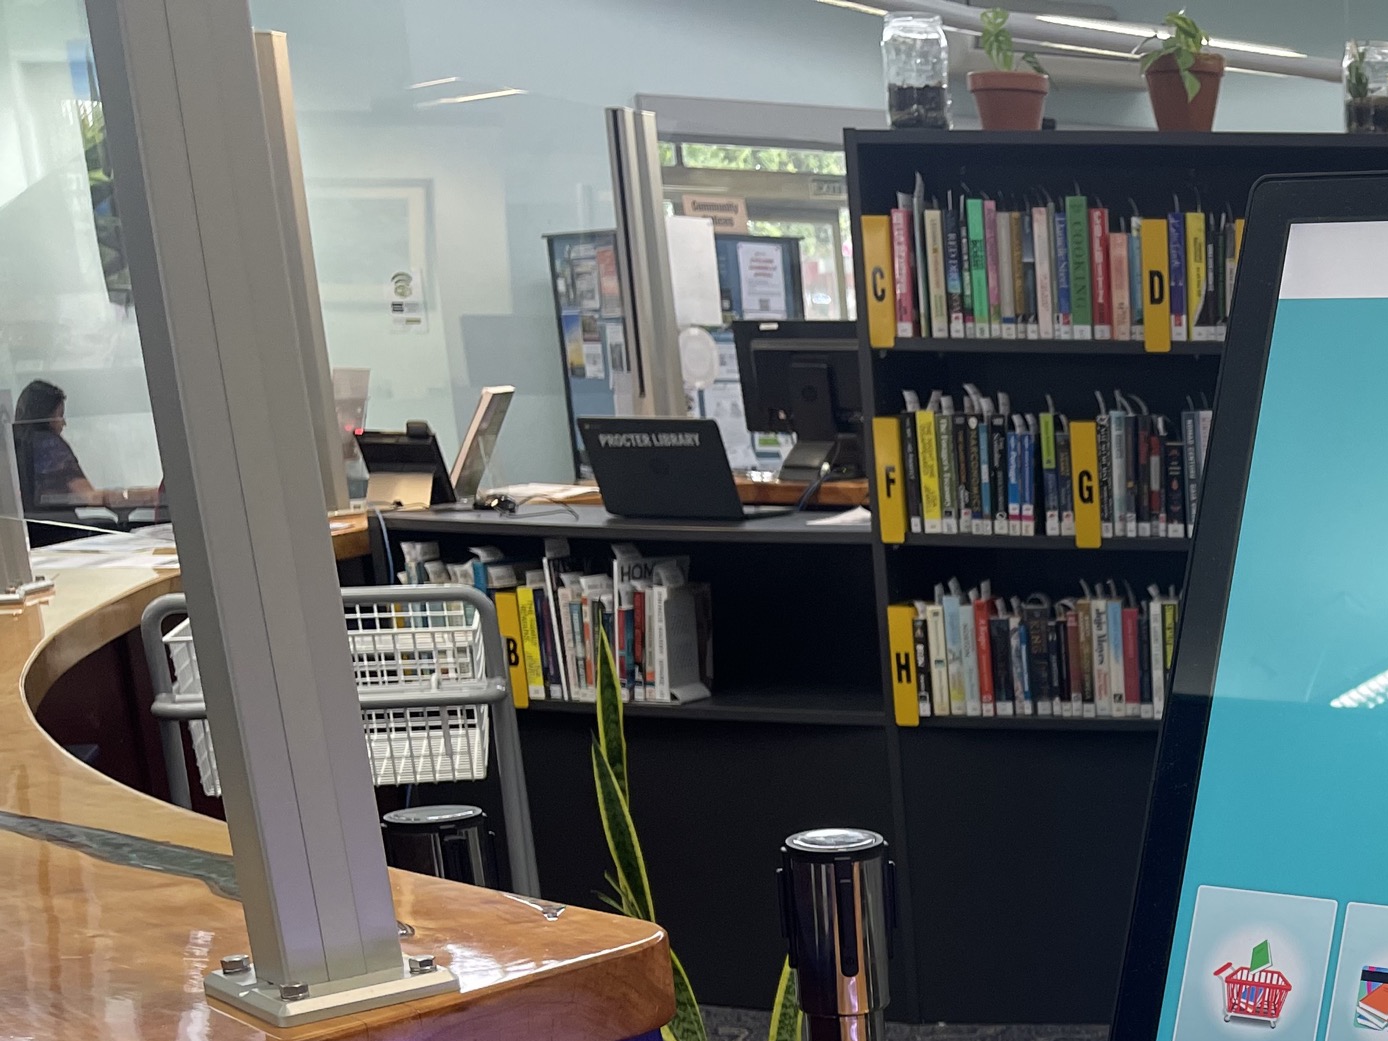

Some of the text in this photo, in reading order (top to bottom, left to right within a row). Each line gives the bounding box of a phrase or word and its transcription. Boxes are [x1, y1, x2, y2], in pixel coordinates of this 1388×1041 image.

[1072, 222, 1085, 309] COOKING
[873, 266, 886, 303] C
[1149, 270, 1165, 305] D
[598, 432, 700, 447] PROCTER LIBRARY
[885, 466, 895, 498] F
[1078, 470, 1094, 504] G
[506, 638, 520, 666] B
[896, 652, 911, 684] H
